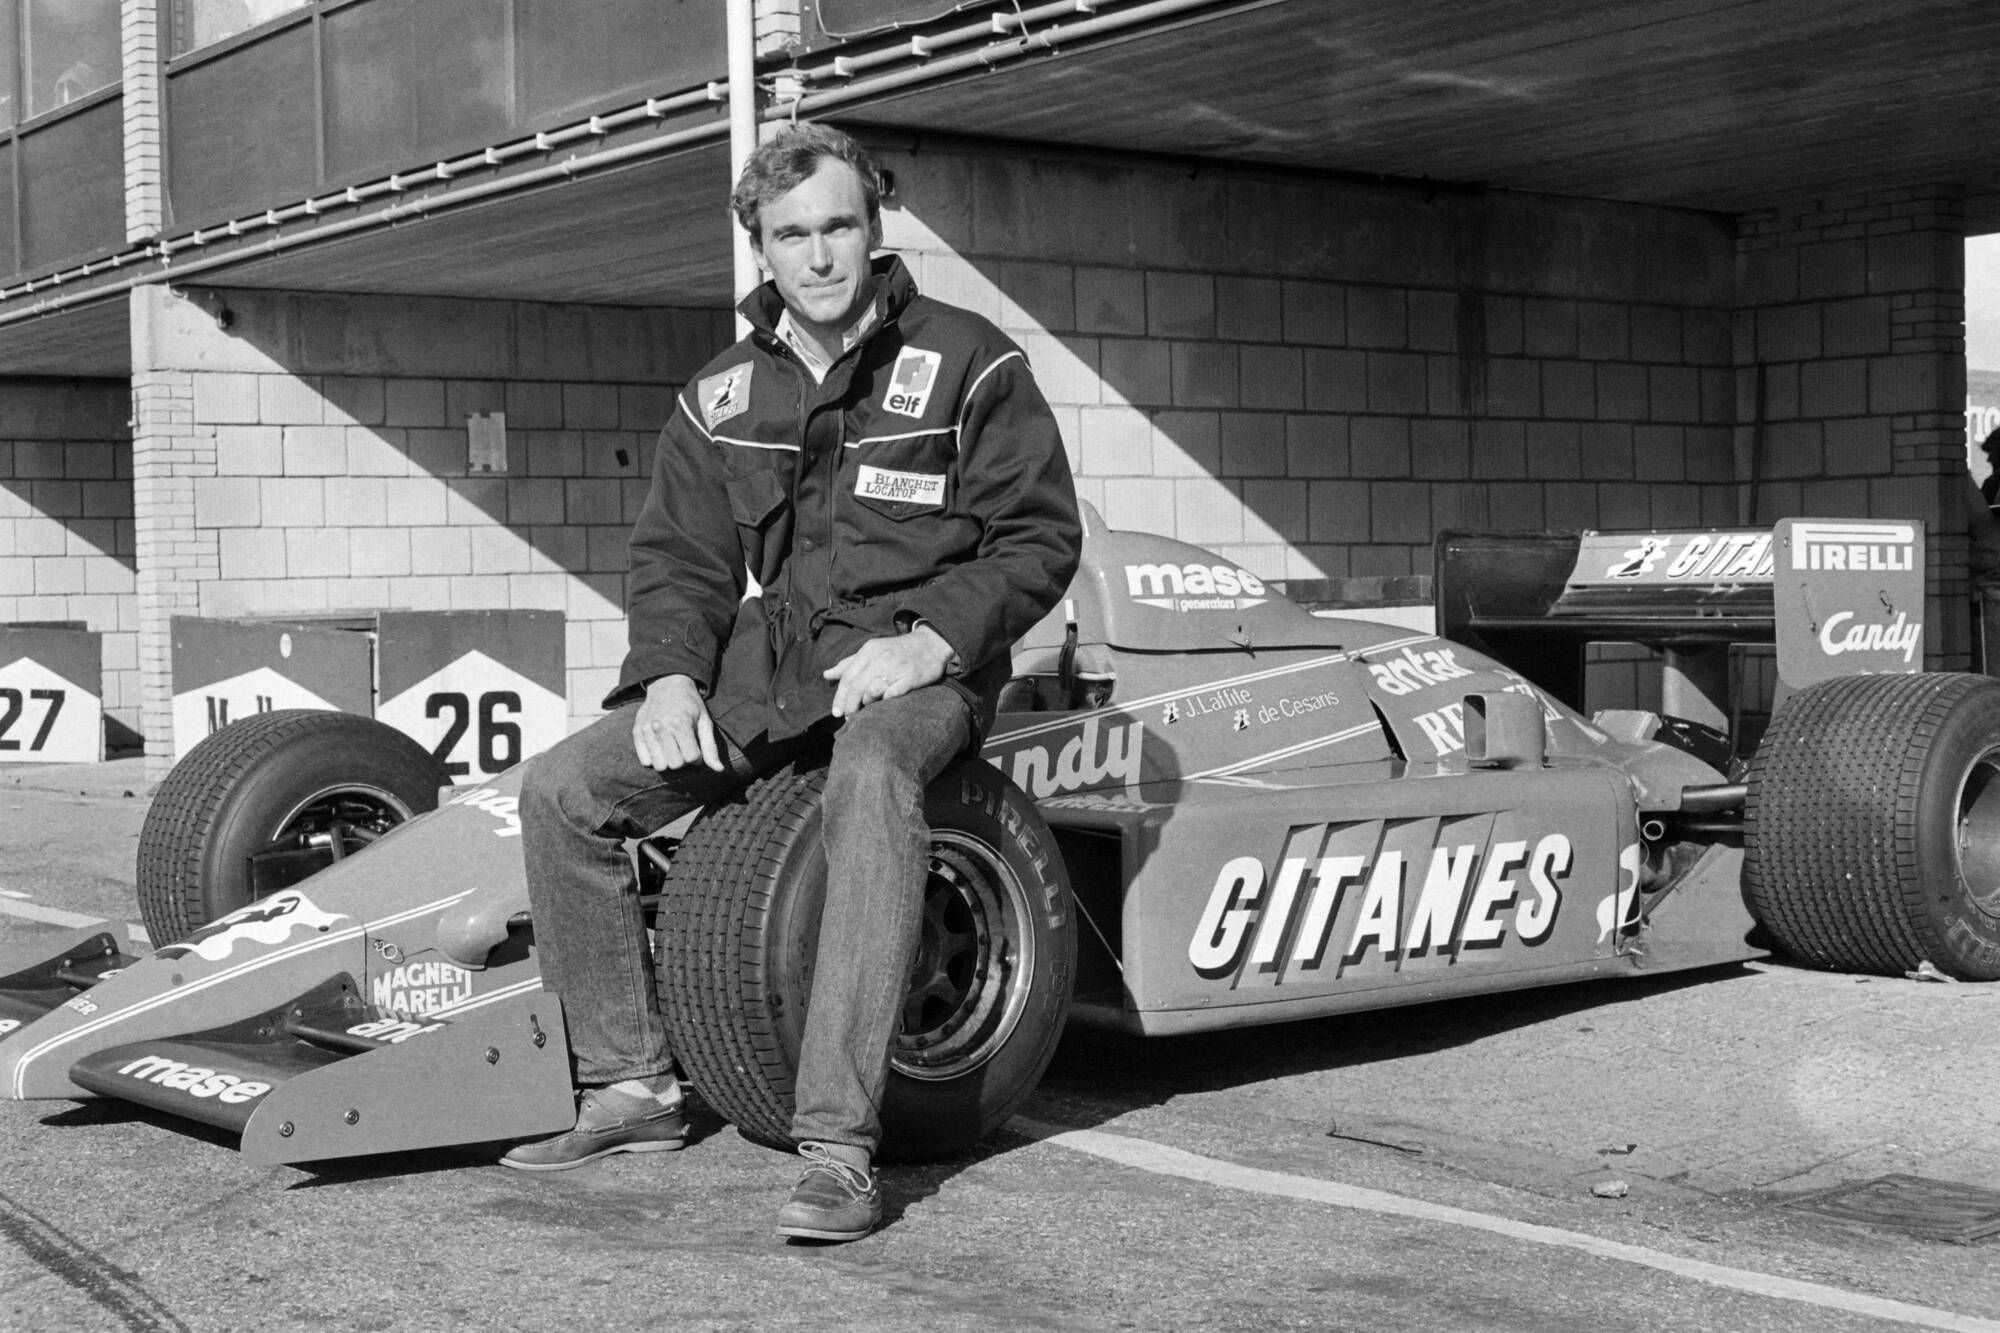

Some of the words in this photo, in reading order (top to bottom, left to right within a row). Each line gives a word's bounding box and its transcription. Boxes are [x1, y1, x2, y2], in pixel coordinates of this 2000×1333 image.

[889, 394, 921, 413] elf
[865, 482, 917, 499] LOCATOP
[874, 472, 939, 491] BLANCHET
[1667, 534, 1775, 578] GITA
[1791, 522, 1915, 571] PIRELLI
[1124, 563, 1266, 596] mase
[1820, 611, 1922, 663] Candy
[1369, 647, 1475, 696] antar
[0, 687, 66, 751] 27
[425, 690, 522, 775] 26
[1258, 705, 1279, 724] de
[986, 716, 1144, 804] ndy
[1188, 833, 1574, 978] GITANES
[117, 1055, 271, 1104] mase
